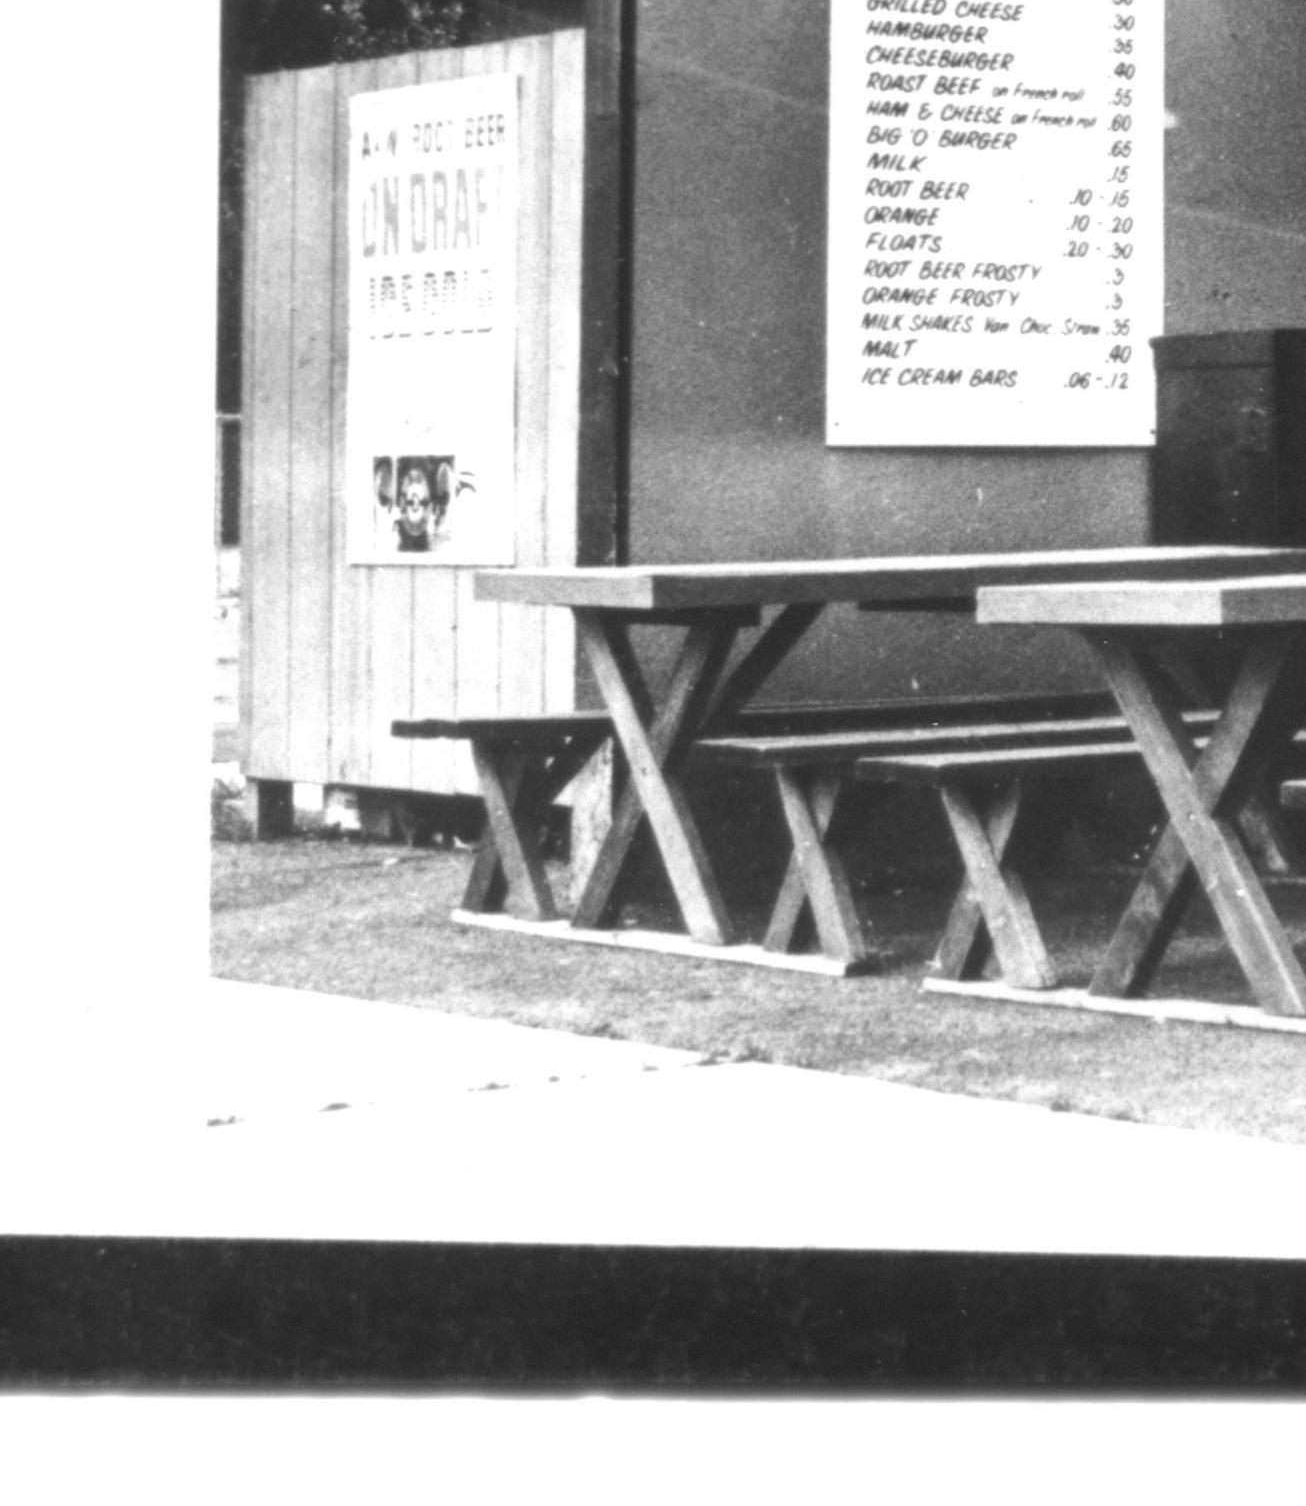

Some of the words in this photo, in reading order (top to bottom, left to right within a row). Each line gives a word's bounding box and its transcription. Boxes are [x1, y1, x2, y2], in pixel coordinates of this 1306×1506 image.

[954, 0, 1025, 22] CHEESE
[865, 20, 989, 44] HAMBURGER
[865, 44, 1015, 72] CHEESEBURGER
[866, 71, 928, 94] ROAST
[932, 74, 982, 96] BEEF
[865, 100, 910, 118] HAM
[917, 102, 934, 121] &
[939, 103, 1005, 125] CHEESE
[866, 124, 903, 146] BIG
[937, 128, 1018, 151] BURGER
[866, 151, 927, 172] MILK
[864, 177, 914, 199] ROOT
[918, 179, 970, 201] BEER
[410, 163, 504, 254] DRAF
[863, 205, 940, 227] ORANGE
[865, 231, 943, 254] FLOATS
[863, 258, 913, 279] ROOT
[918, 259, 966, 281] BEER
[971, 262, 1042, 283] FROSTY
[861, 285, 939, 307] ORANGE
[949, 288, 1020, 308] FROSTY
[861, 312, 905, 332] MILK
[908, 313, 974, 334] SHAKES
[862, 338, 918, 360] MALT
[861, 367, 893, 386] ICE
[897, 367, 964, 387] CREAM
[968, 368, 1018, 388] BARS
